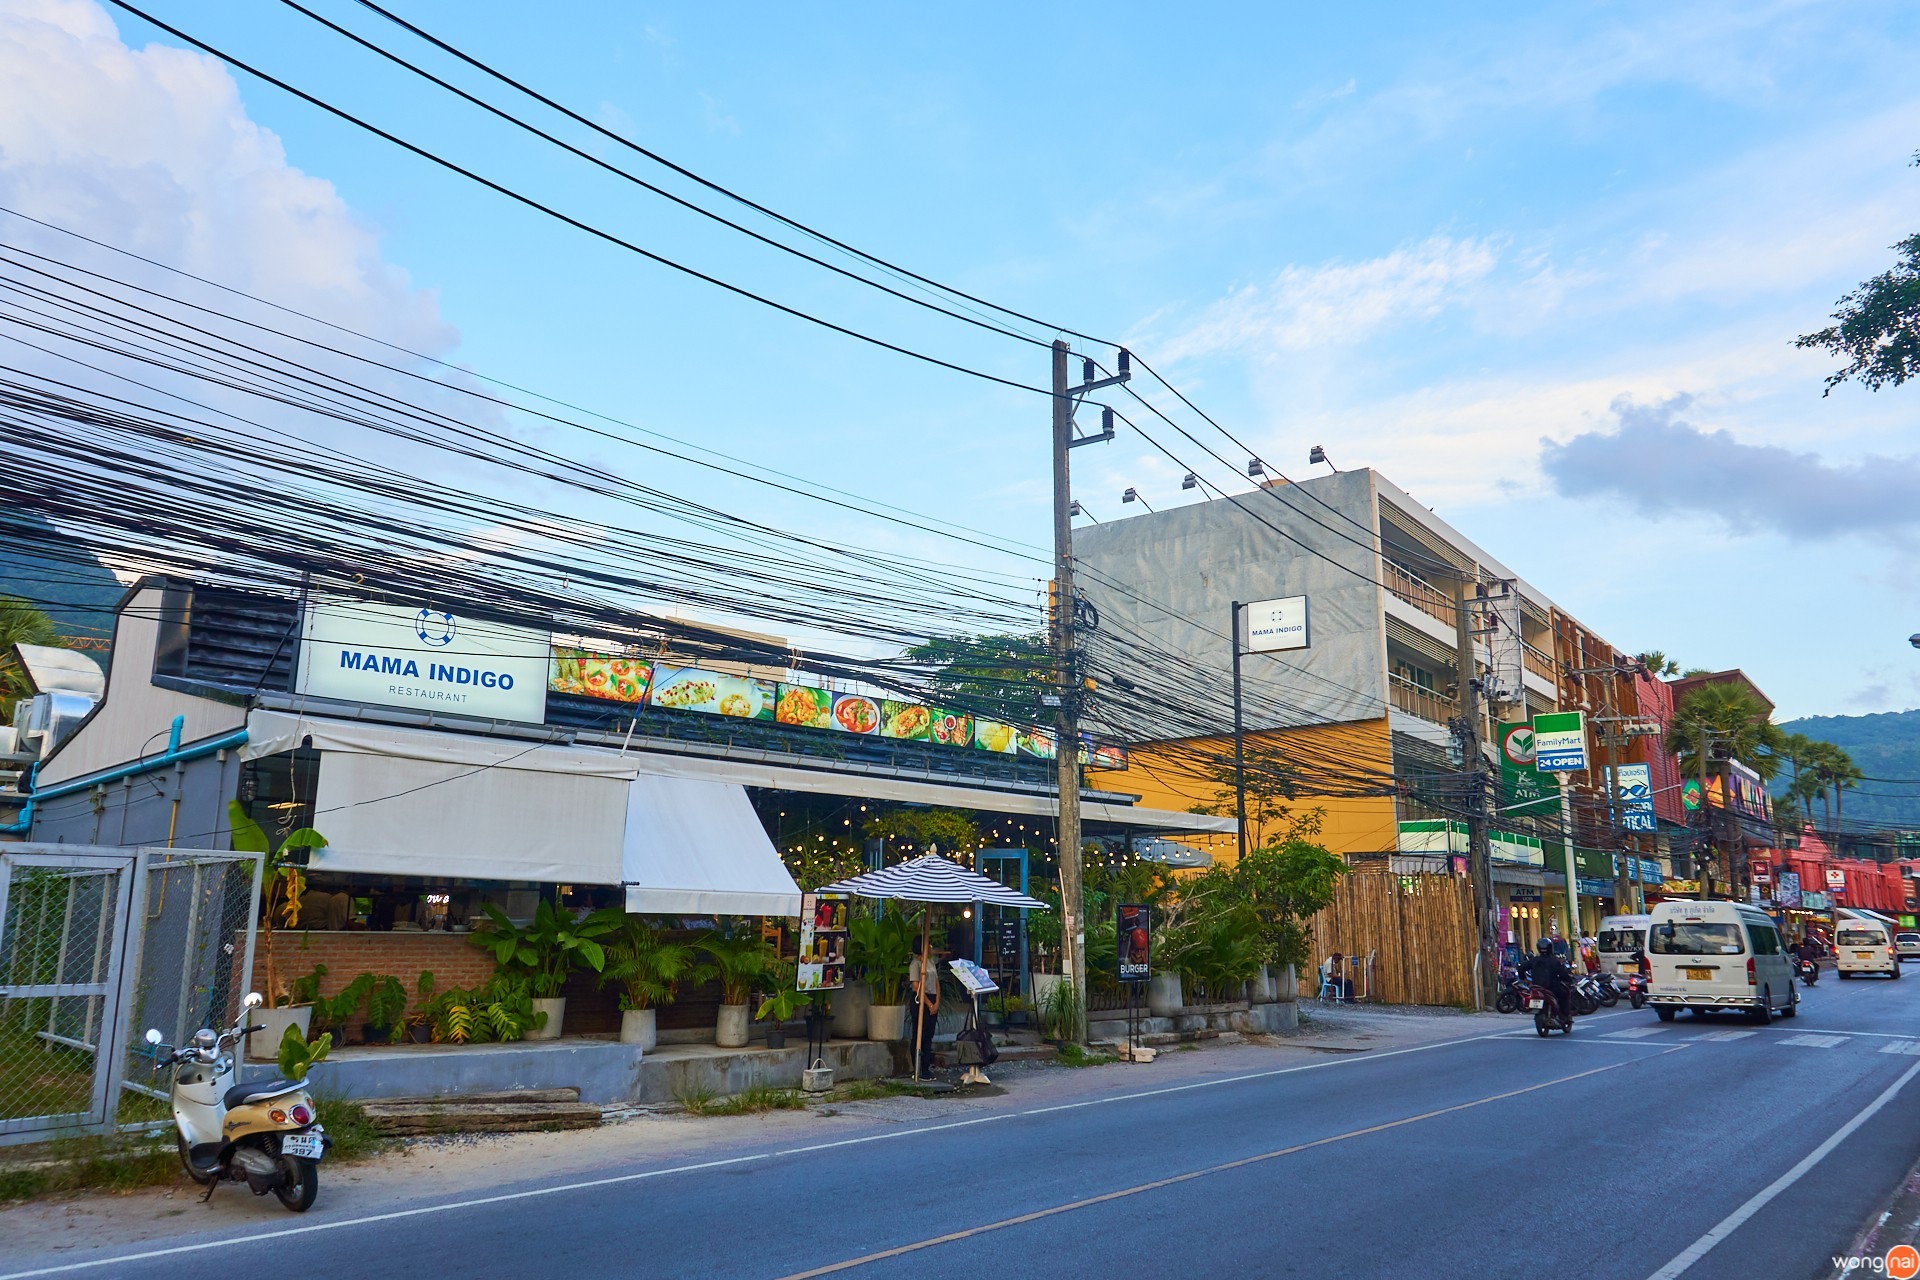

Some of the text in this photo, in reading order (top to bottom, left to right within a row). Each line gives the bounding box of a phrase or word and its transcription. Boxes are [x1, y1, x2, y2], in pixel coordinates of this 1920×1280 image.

[1252, 625, 1302, 636] MAMA INDIGO
[340, 651, 514, 690] MAMA INDIGO
[388, 685, 467, 703] RESTAURANT
[1536, 737, 1581, 747] FamilyMart
[1540, 757, 1582, 767] 24 OPEN
[1516, 888, 1535, 896] ATM
[1120, 963, 1149, 974] BURGER
